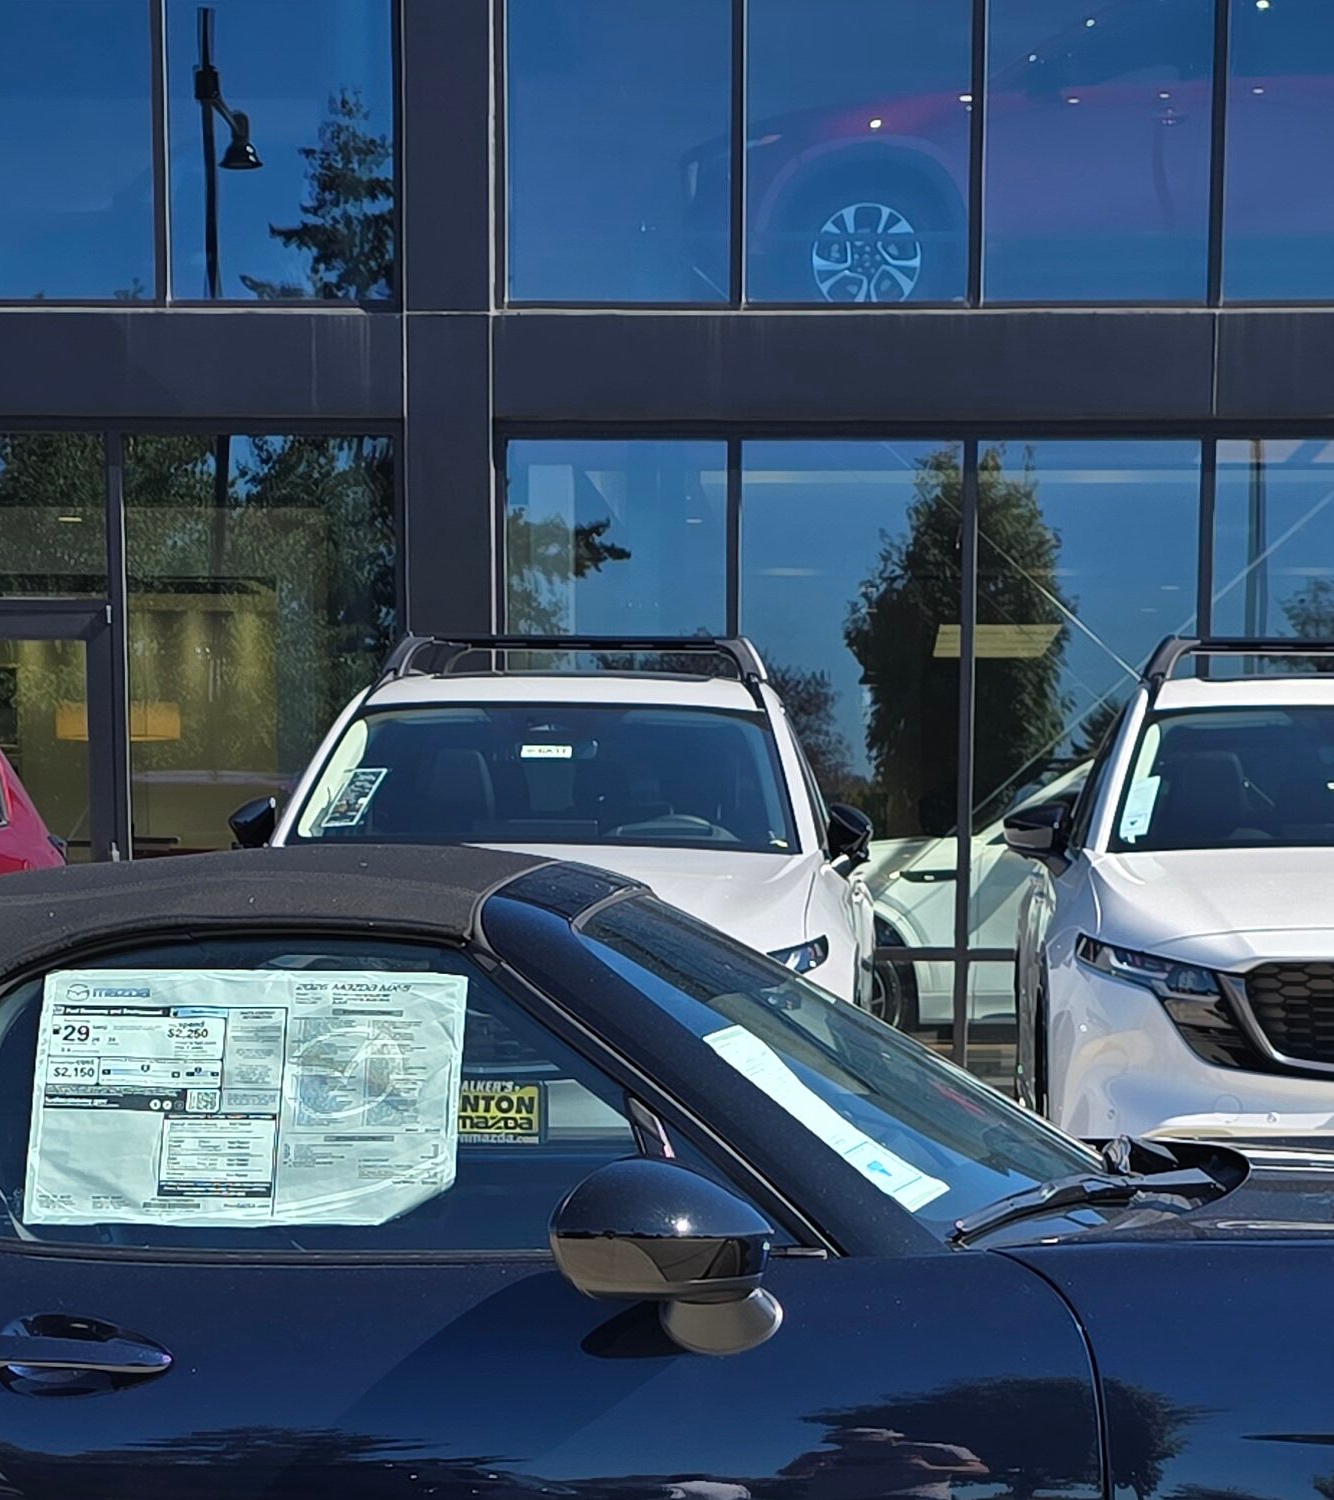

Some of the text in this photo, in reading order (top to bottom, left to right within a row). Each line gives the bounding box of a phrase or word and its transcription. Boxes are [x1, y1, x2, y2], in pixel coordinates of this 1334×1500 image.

[92, 987, 150, 998] mazda
[62, 1025, 90, 1042] 29
[461, 1080, 515, 1093] ALKER'S
[461, 1094, 535, 1115] NTON
